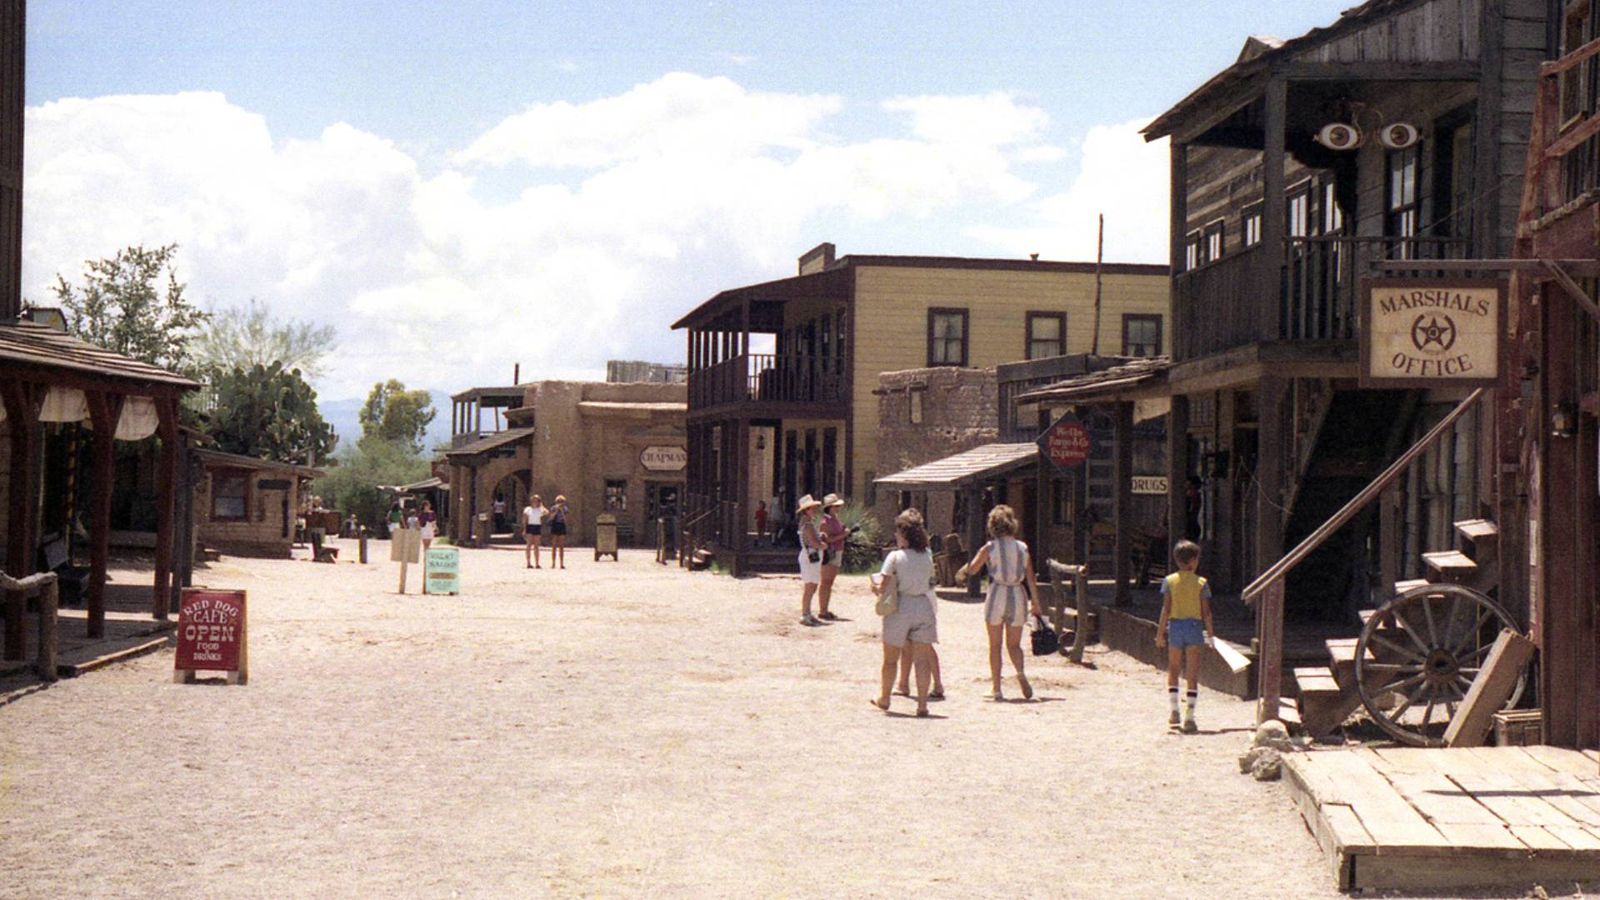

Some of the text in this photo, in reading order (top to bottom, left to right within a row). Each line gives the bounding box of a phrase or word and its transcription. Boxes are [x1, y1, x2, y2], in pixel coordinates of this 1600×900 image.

[1380, 290, 1490, 316] MARSHALS
[1392, 352, 1473, 376] OFFICE
[183, 600, 239, 617] RED DOG
[193, 609, 228, 624] CAFE
[185, 625, 234, 642] OPEN
[196, 642, 220, 650] FOOD
